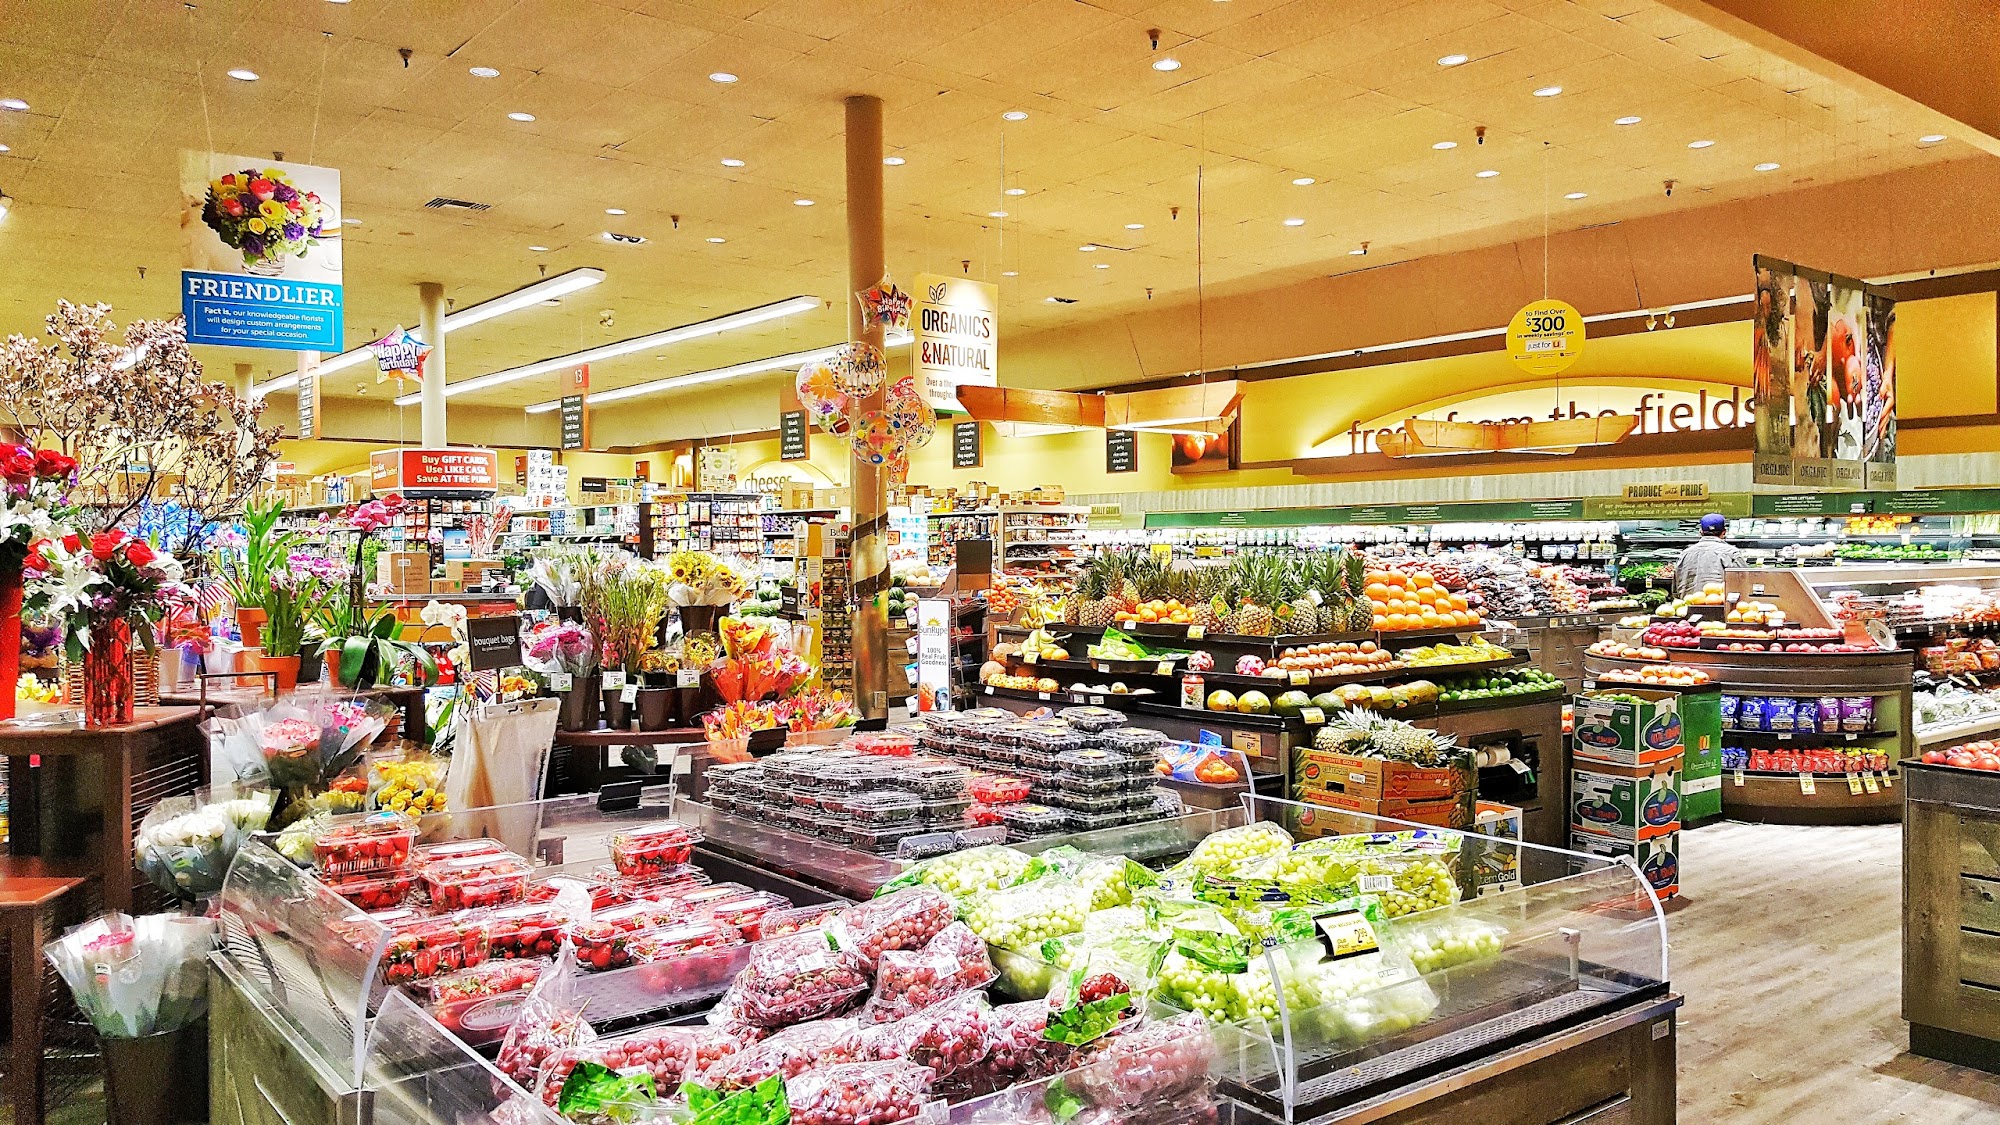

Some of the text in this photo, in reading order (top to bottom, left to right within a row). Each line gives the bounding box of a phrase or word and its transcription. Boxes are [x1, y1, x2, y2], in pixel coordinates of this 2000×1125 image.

[188, 277, 341, 307] FRIENDLIER.
[204, 307, 221, 315] Fact
[247, 310, 300, 321] knowledgeable
[301, 314, 324, 323] florists
[221, 318, 246, 327] design
[247, 319, 273, 327] custom
[274, 321, 322, 331] arrangements
[922, 308, 990, 339] ORGANICS
[1526, 316, 1565, 333] $300
[221, 326, 231, 334] for
[232, 328, 249, 336] your
[250, 328, 275, 338] special
[377, 343, 416, 361] Happy
[1528, 342, 1541, 351] just
[380, 357, 418, 371] Birthday!
[574, 369, 583, 383] 13
[925, 376, 938, 386] Over
[1635, 386, 1755, 434] fields
[421, 455, 440, 465] Buy
[441, 455, 463, 464] GIFT
[425, 465, 443, 474] Use
[444, 465, 464, 474] LIKE
[1760, 463, 1894, 483] ORGANIC ORGANIC ORGANIC ORGANIC
[416, 474, 439, 483] Save
[439, 475, 454, 483] AT
[454, 475, 471, 483] THE
[1628, 484, 1663, 498] PRODUCE
[1680, 483, 1703, 497] PRIDE
[1091, 506, 1107, 515] OCALLY
[919, 626, 948, 636] SunRype
[473, 634, 516, 647] bouquet bags
[1323, 756, 1342, 765] MONTE
[1342, 759, 1358, 767] GOLD
[1409, 772, 1422, 780] DEL
[1321, 795, 1340, 804] MONTE
[1417, 806, 1439, 814] MONTE
[1498, 870, 1515, 881] Gold
